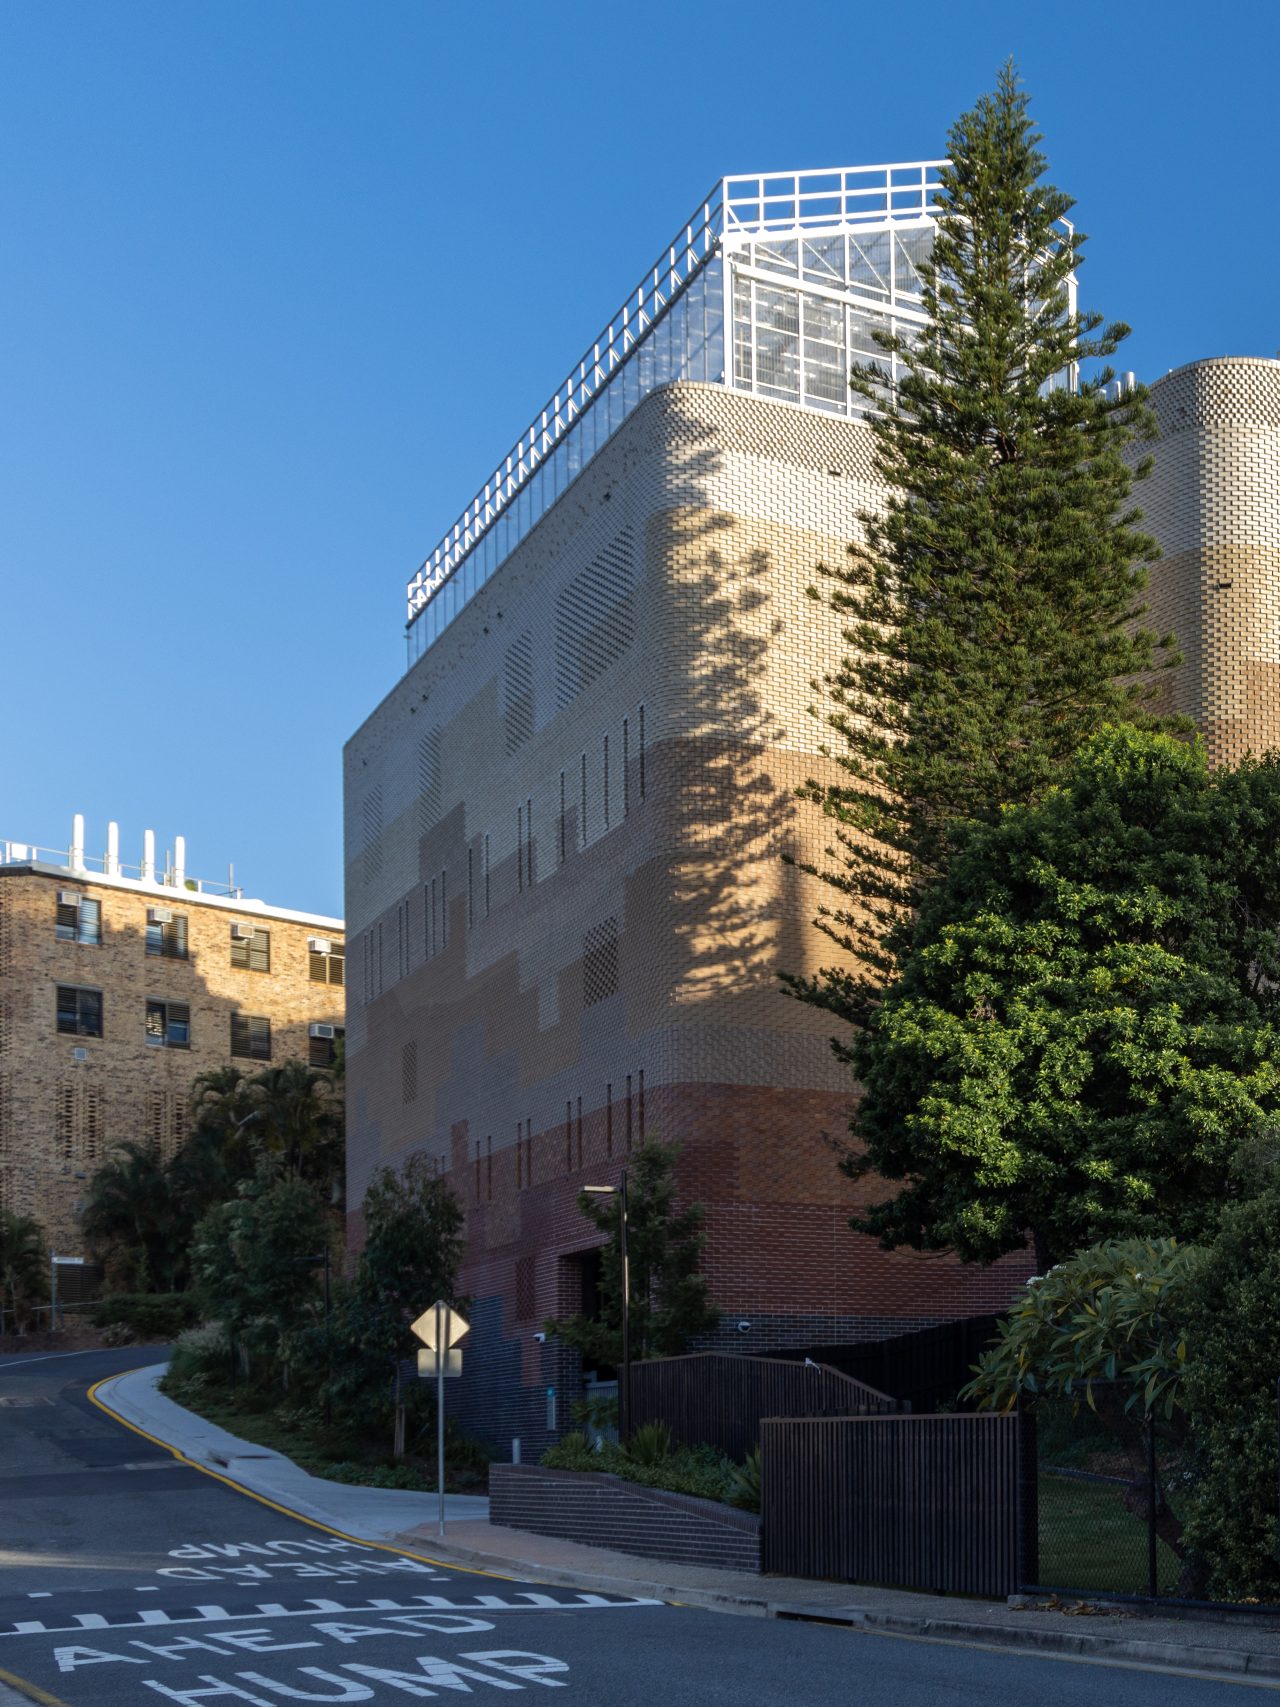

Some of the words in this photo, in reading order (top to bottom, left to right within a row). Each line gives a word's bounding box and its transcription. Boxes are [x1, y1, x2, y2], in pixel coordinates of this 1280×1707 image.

[168, 1538, 374, 1559] HUMP
[156, 1558, 436, 1580] AHEAD
[53, 1614, 496, 1672] AHEAD
[142, 1650, 570, 1707] HUMP
